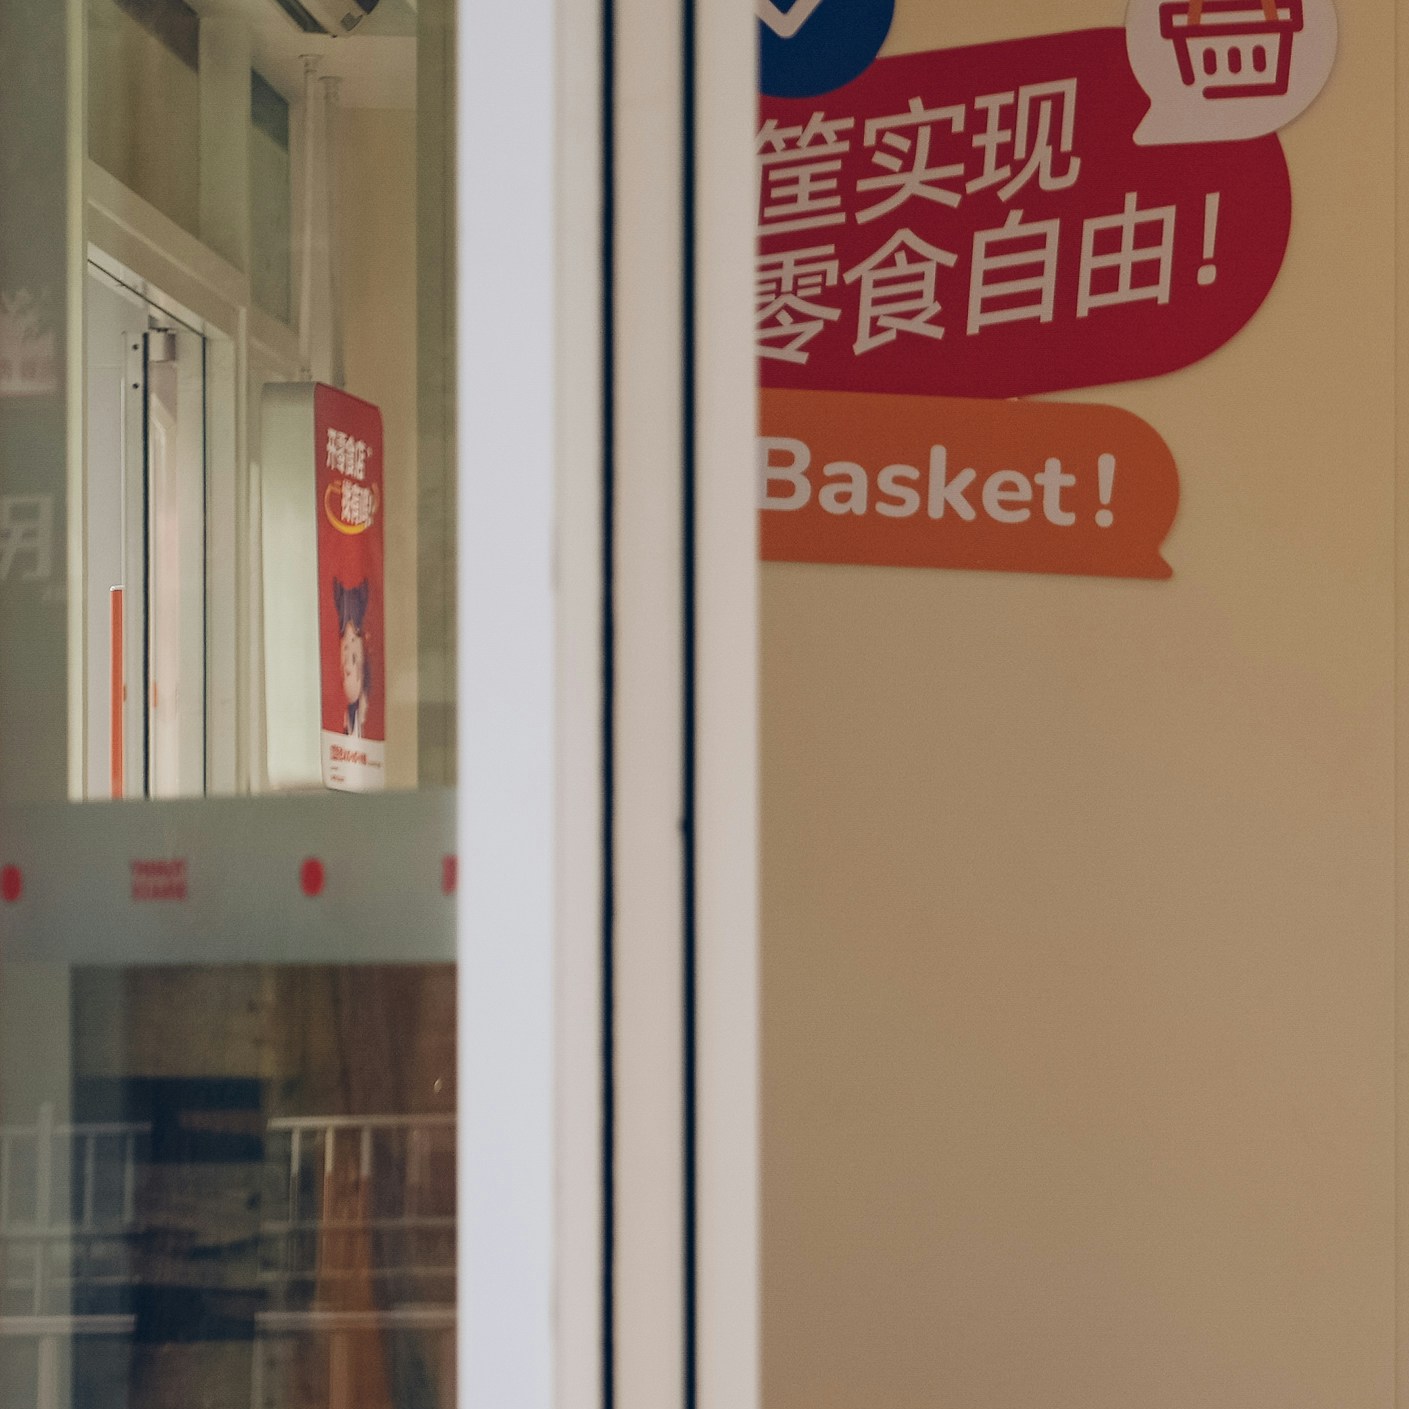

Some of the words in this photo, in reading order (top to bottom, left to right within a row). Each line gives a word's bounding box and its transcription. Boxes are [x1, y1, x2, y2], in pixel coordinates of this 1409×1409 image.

[757, 192, 1221, 364] 零食自由!
[757, 436, 1116, 528] Basket!
